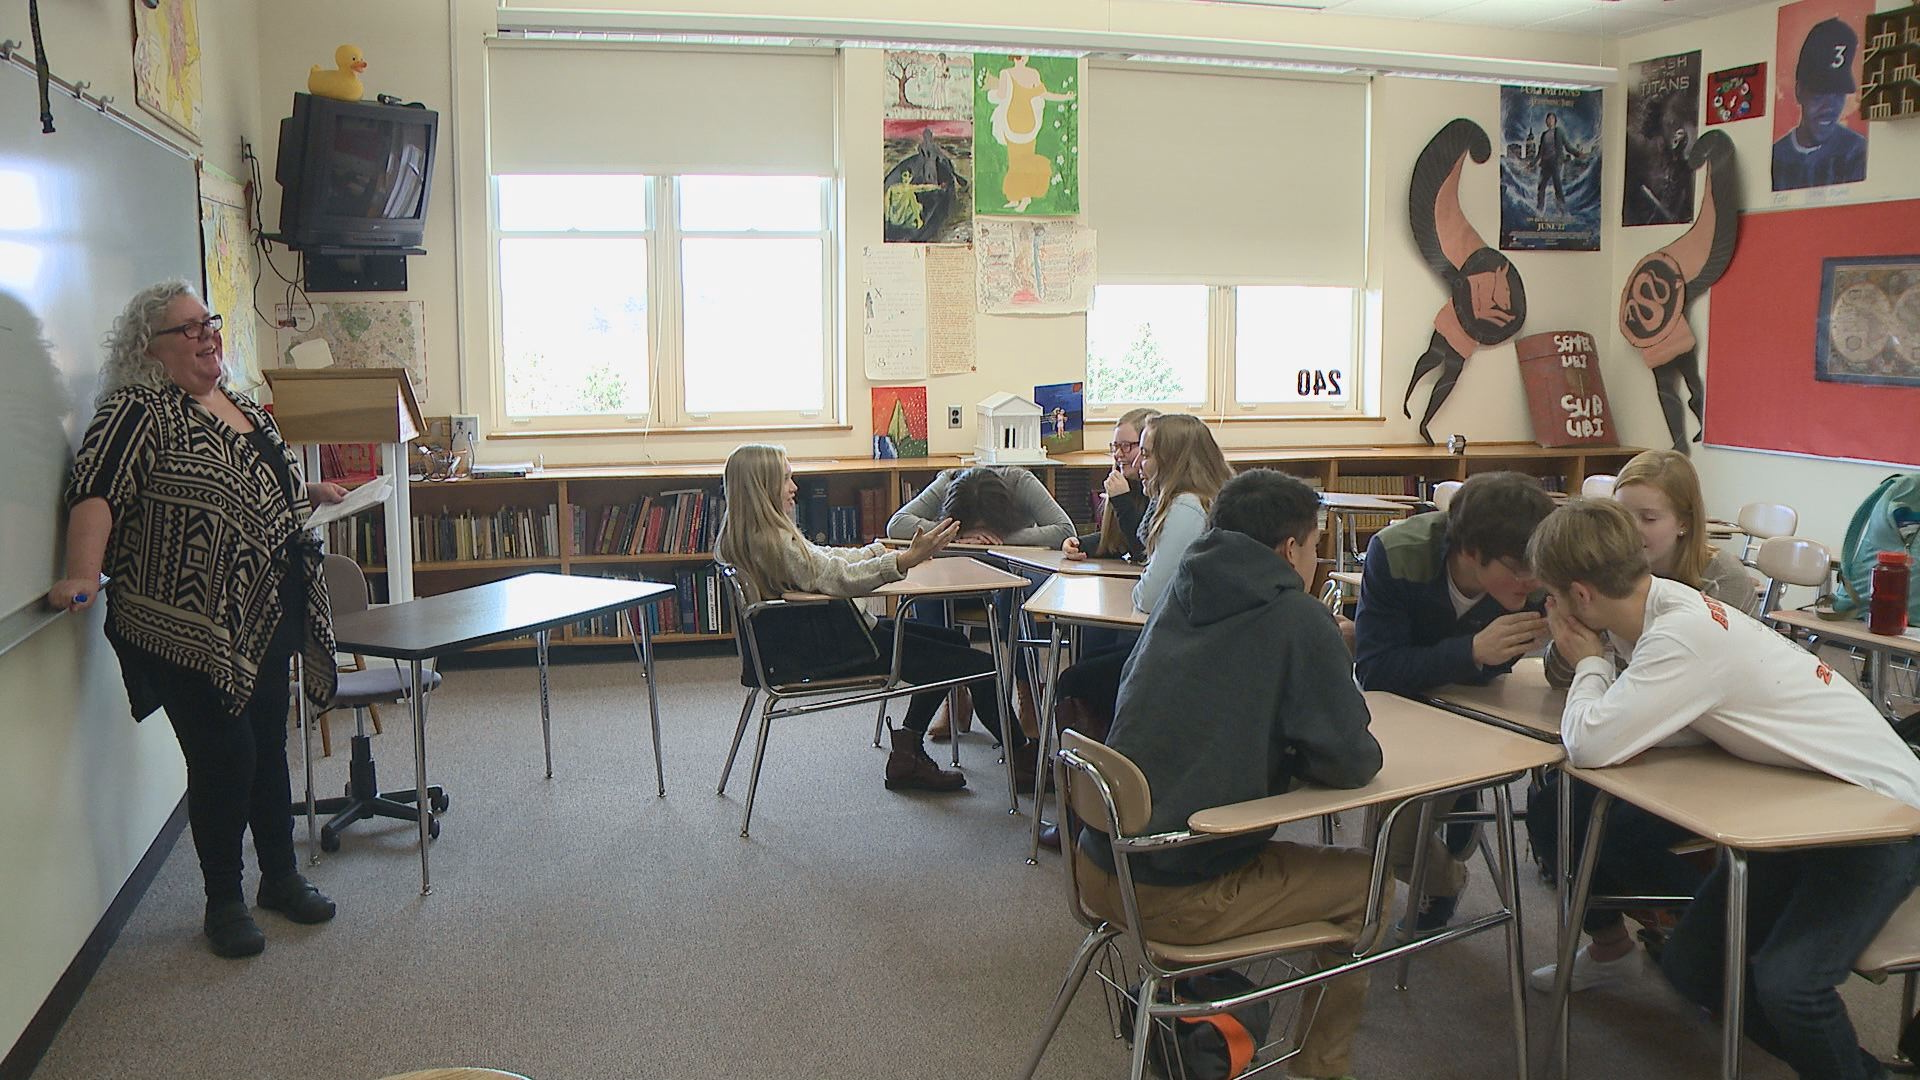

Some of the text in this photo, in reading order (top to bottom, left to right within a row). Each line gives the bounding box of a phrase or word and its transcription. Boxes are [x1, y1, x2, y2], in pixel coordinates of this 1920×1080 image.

[1831, 45, 1847, 68] 3
[1640, 76, 1690, 98] TITANS
[1561, 354, 1587, 369] UBI
[1561, 394, 1603, 418] SUB
[1566, 418, 1604, 437] UBI
